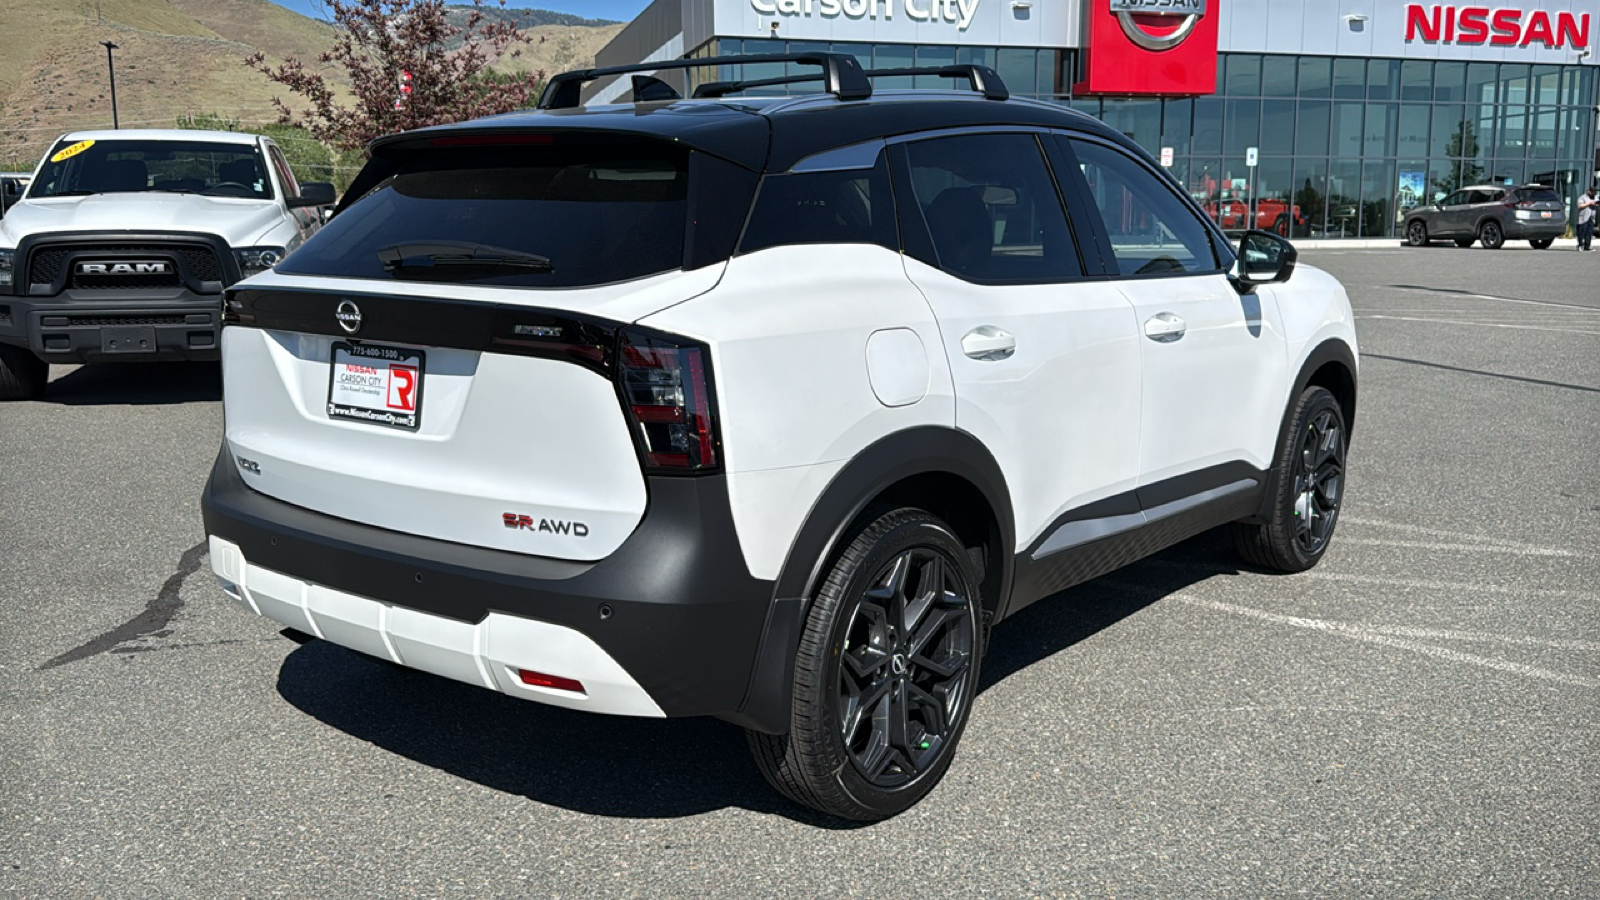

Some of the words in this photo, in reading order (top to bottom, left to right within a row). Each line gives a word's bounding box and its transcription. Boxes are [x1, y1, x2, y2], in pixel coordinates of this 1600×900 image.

[905, 0, 980, 32] City
[1404, 4, 1591, 49] NISSAN
[82, 263, 166, 274] RAM
[353, 346, 399, 359] 775-600-1500
[345, 364, 378, 375] NISSAN
[340, 373, 367, 384] CARSON
[368, 376, 382, 387] CITY
[334, 407, 408, 424] www.NissanCarsonCity.com
[502, 512, 536, 532] SR
[539, 518, 589, 537] AWD
